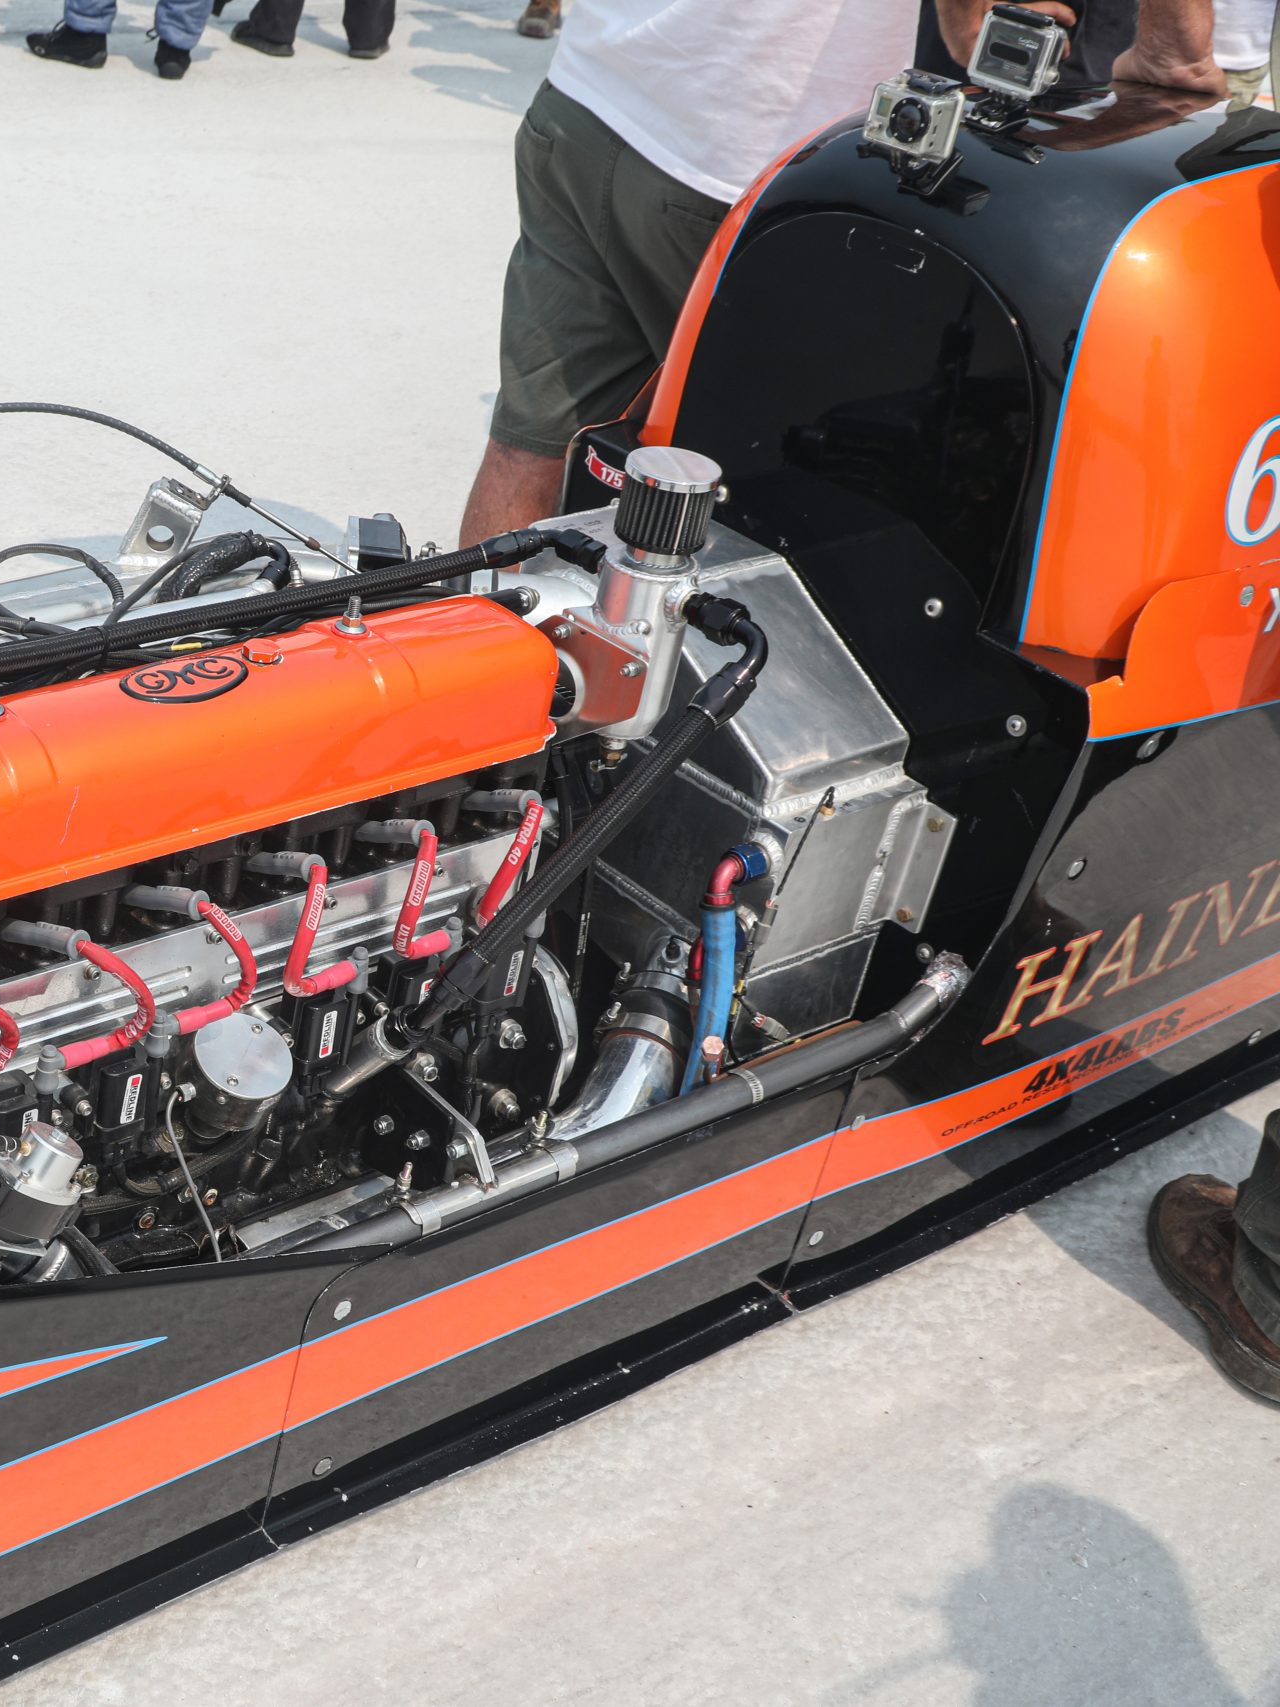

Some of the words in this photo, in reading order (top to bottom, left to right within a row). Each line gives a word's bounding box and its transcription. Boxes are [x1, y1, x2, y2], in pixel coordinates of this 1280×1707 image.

[601, 467, 623, 488] 175
[134, 658, 234, 694] GMC
[516, 807, 539, 846] ULTRA
[507, 846, 522, 866] 40
[410, 861, 430, 906] MOROSO
[213, 906, 241, 940] MOROSO
[307, 884, 325, 930] MOROSO
[1022, 1007, 1187, 1094] 4X4LABS
[941, 1101, 1018, 1137] OFFROAD
[1022, 1064, 1102, 1105] RESEARCH
